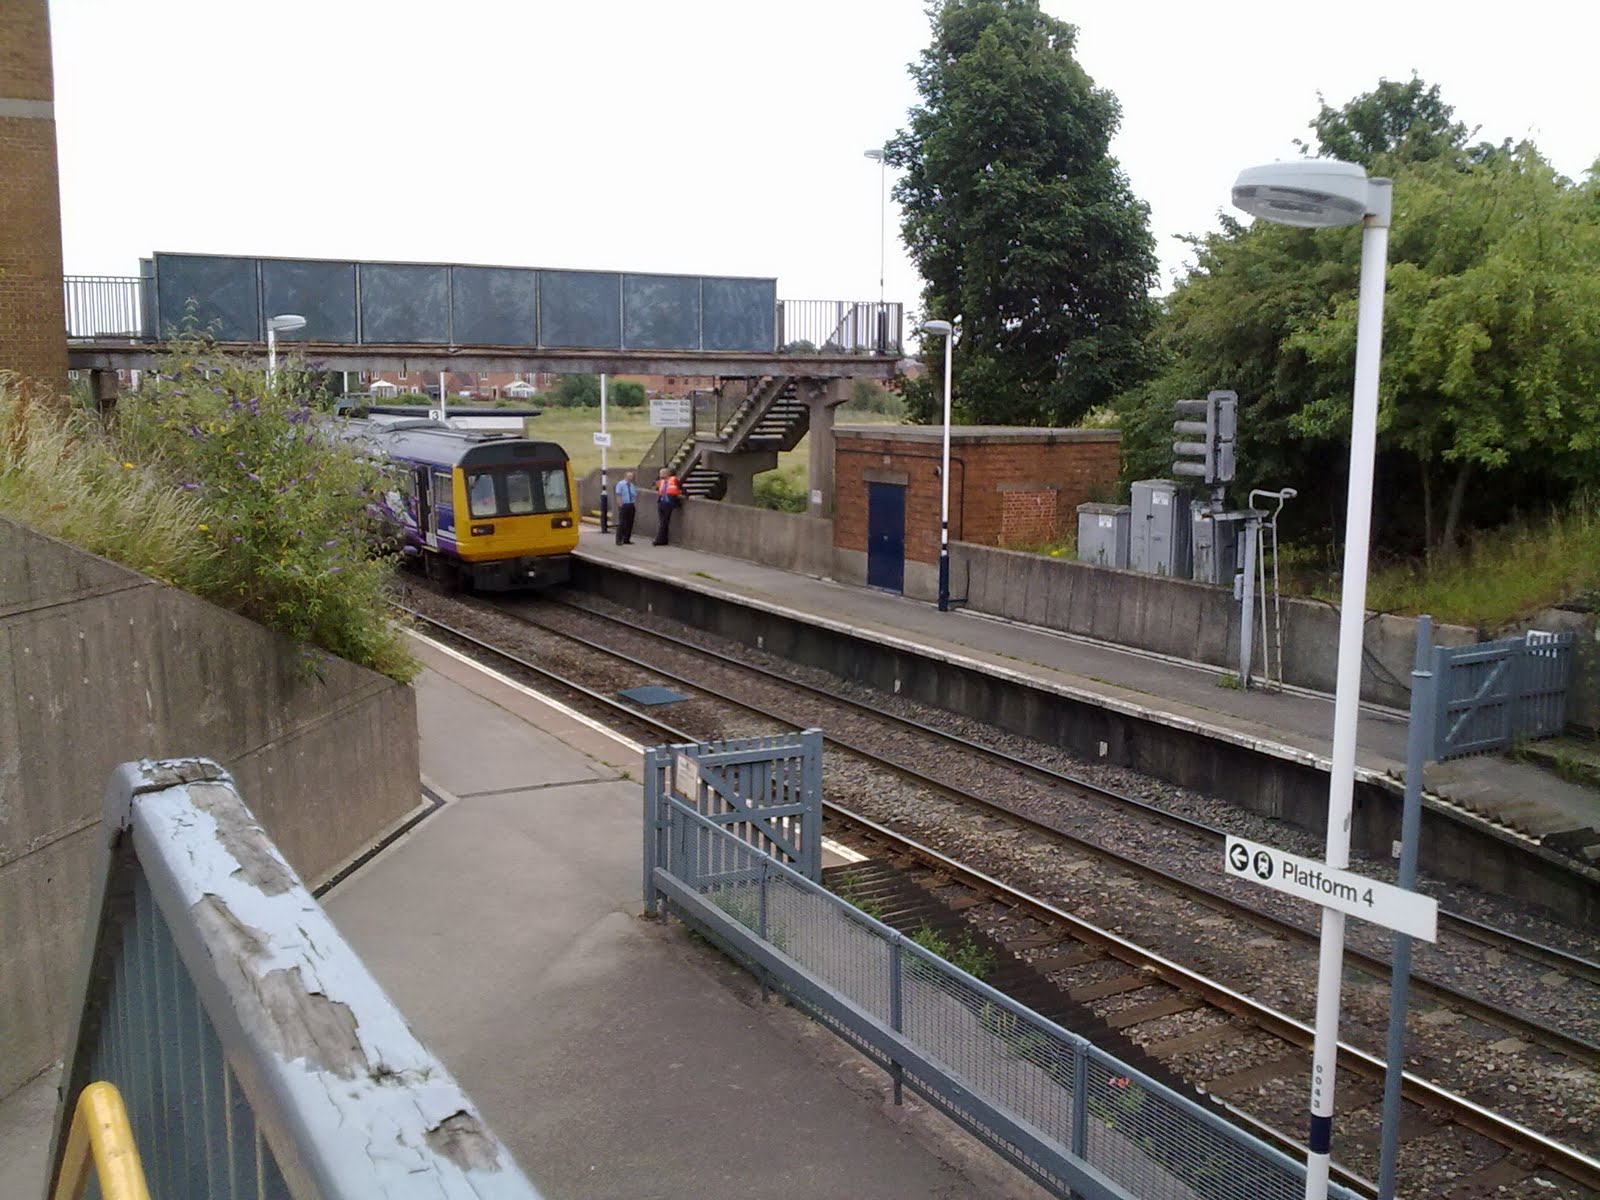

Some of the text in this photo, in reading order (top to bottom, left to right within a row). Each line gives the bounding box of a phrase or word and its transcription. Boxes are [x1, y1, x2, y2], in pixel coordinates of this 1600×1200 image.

[431, 410, 439, 420] 3
[1282, 860, 1374, 908] Platform 4
